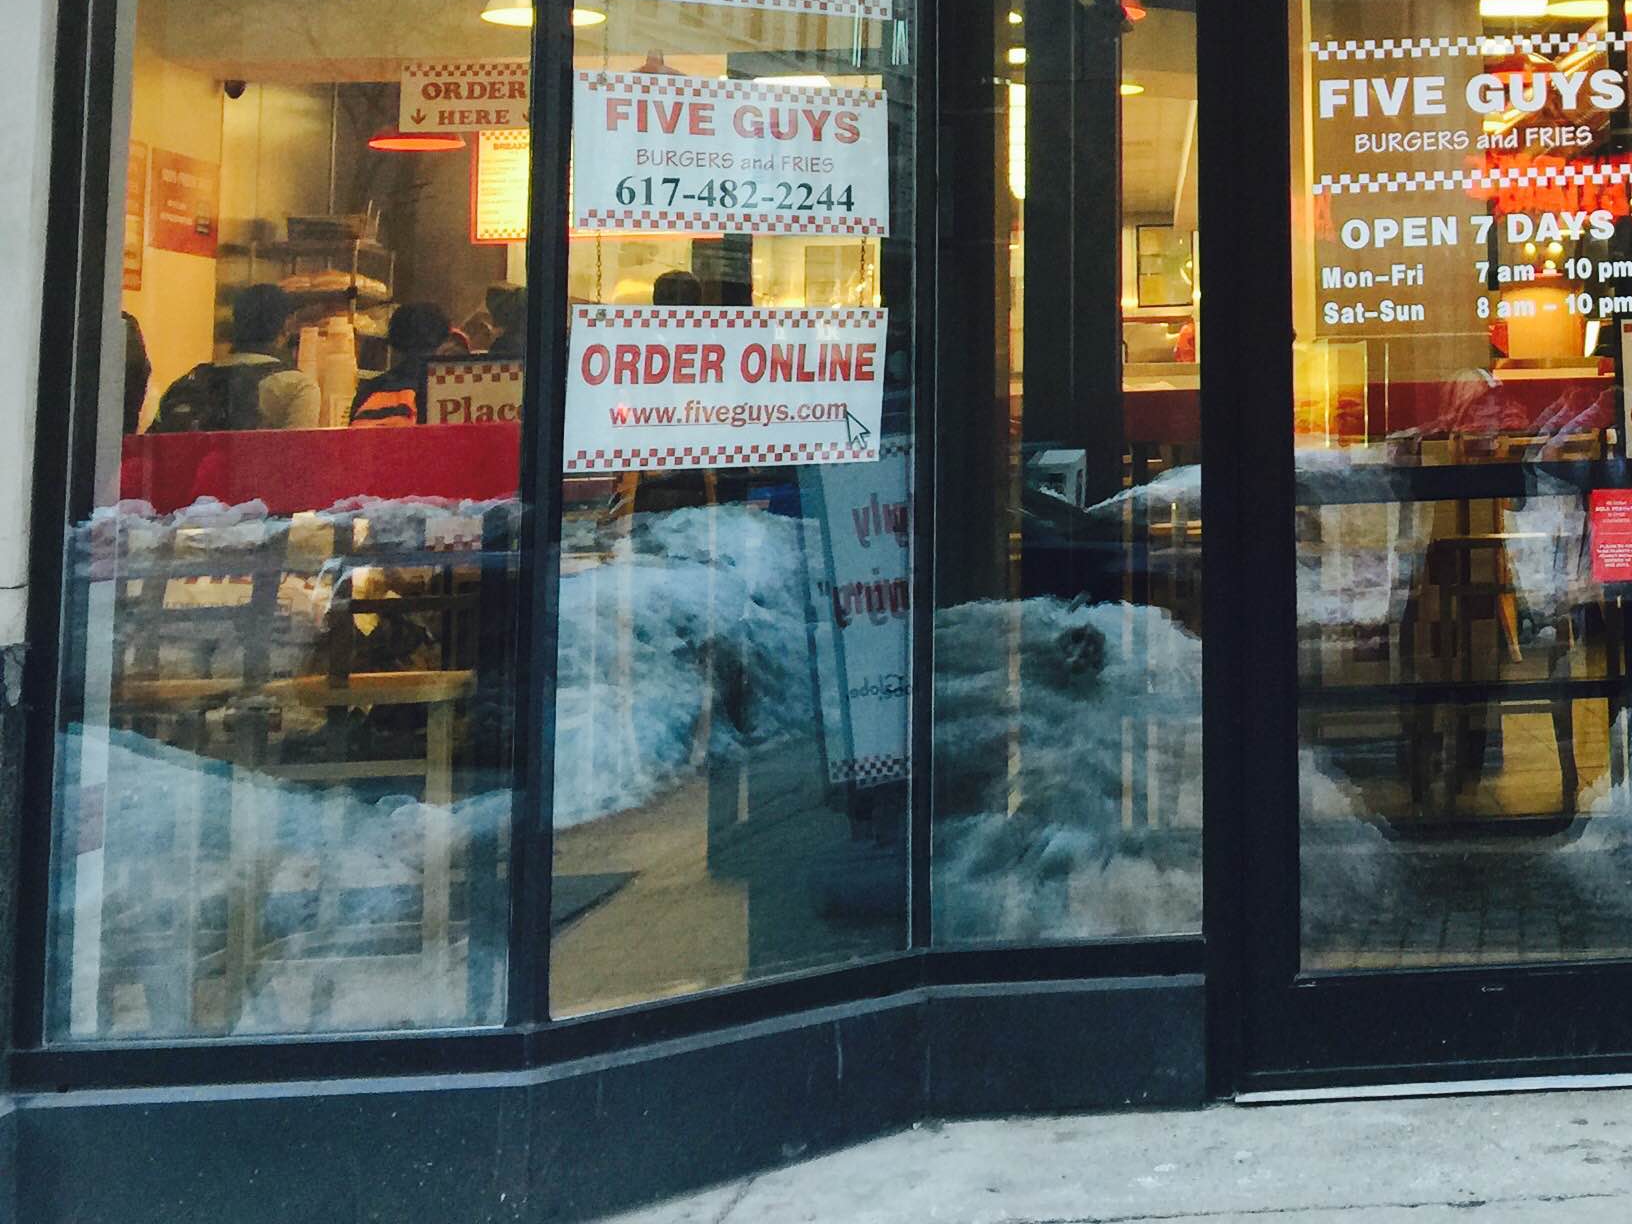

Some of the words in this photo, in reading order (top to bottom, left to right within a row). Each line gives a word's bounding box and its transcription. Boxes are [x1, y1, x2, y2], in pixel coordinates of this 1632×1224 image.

[421, 80, 527, 101] ORDER
[1318, 76, 1447, 119] FIVE
[1465, 68, 1627, 115] GUYS
[437, 109, 510, 126] HERE
[605, 97, 716, 137] FIVE
[732, 103, 862, 145] GUYS
[1354, 129, 1470, 154] BURGERS
[1476, 127, 1519, 150] and
[1525, 125, 1594, 147] FRIES
[636, 148, 735, 169] BURGERS
[740, 154, 775, 172] and
[781, 155, 835, 174] FRIES
[615, 175, 855, 213] 617-482-2244
[1340, 215, 1458, 250] OPEN
[1470, 214, 1494, 245] 7
[1507, 209, 1616, 244] DAYS
[1321, 263, 1425, 289] Mon-Fri
[1475, 261, 1490, 284] 7
[1497, 263, 1536, 283] am
[1564, 257, 1592, 280] 10
[1323, 299, 1426, 325] Sat-Sun
[1476, 296, 1490, 319] 8
[1496, 297, 1537, 318] am
[1564, 291, 1593, 315] 10
[580, 342, 727, 386] ORDER
[740, 342, 877, 384] ONLINE
[608, 399, 848, 428] www.fiveguys.com
